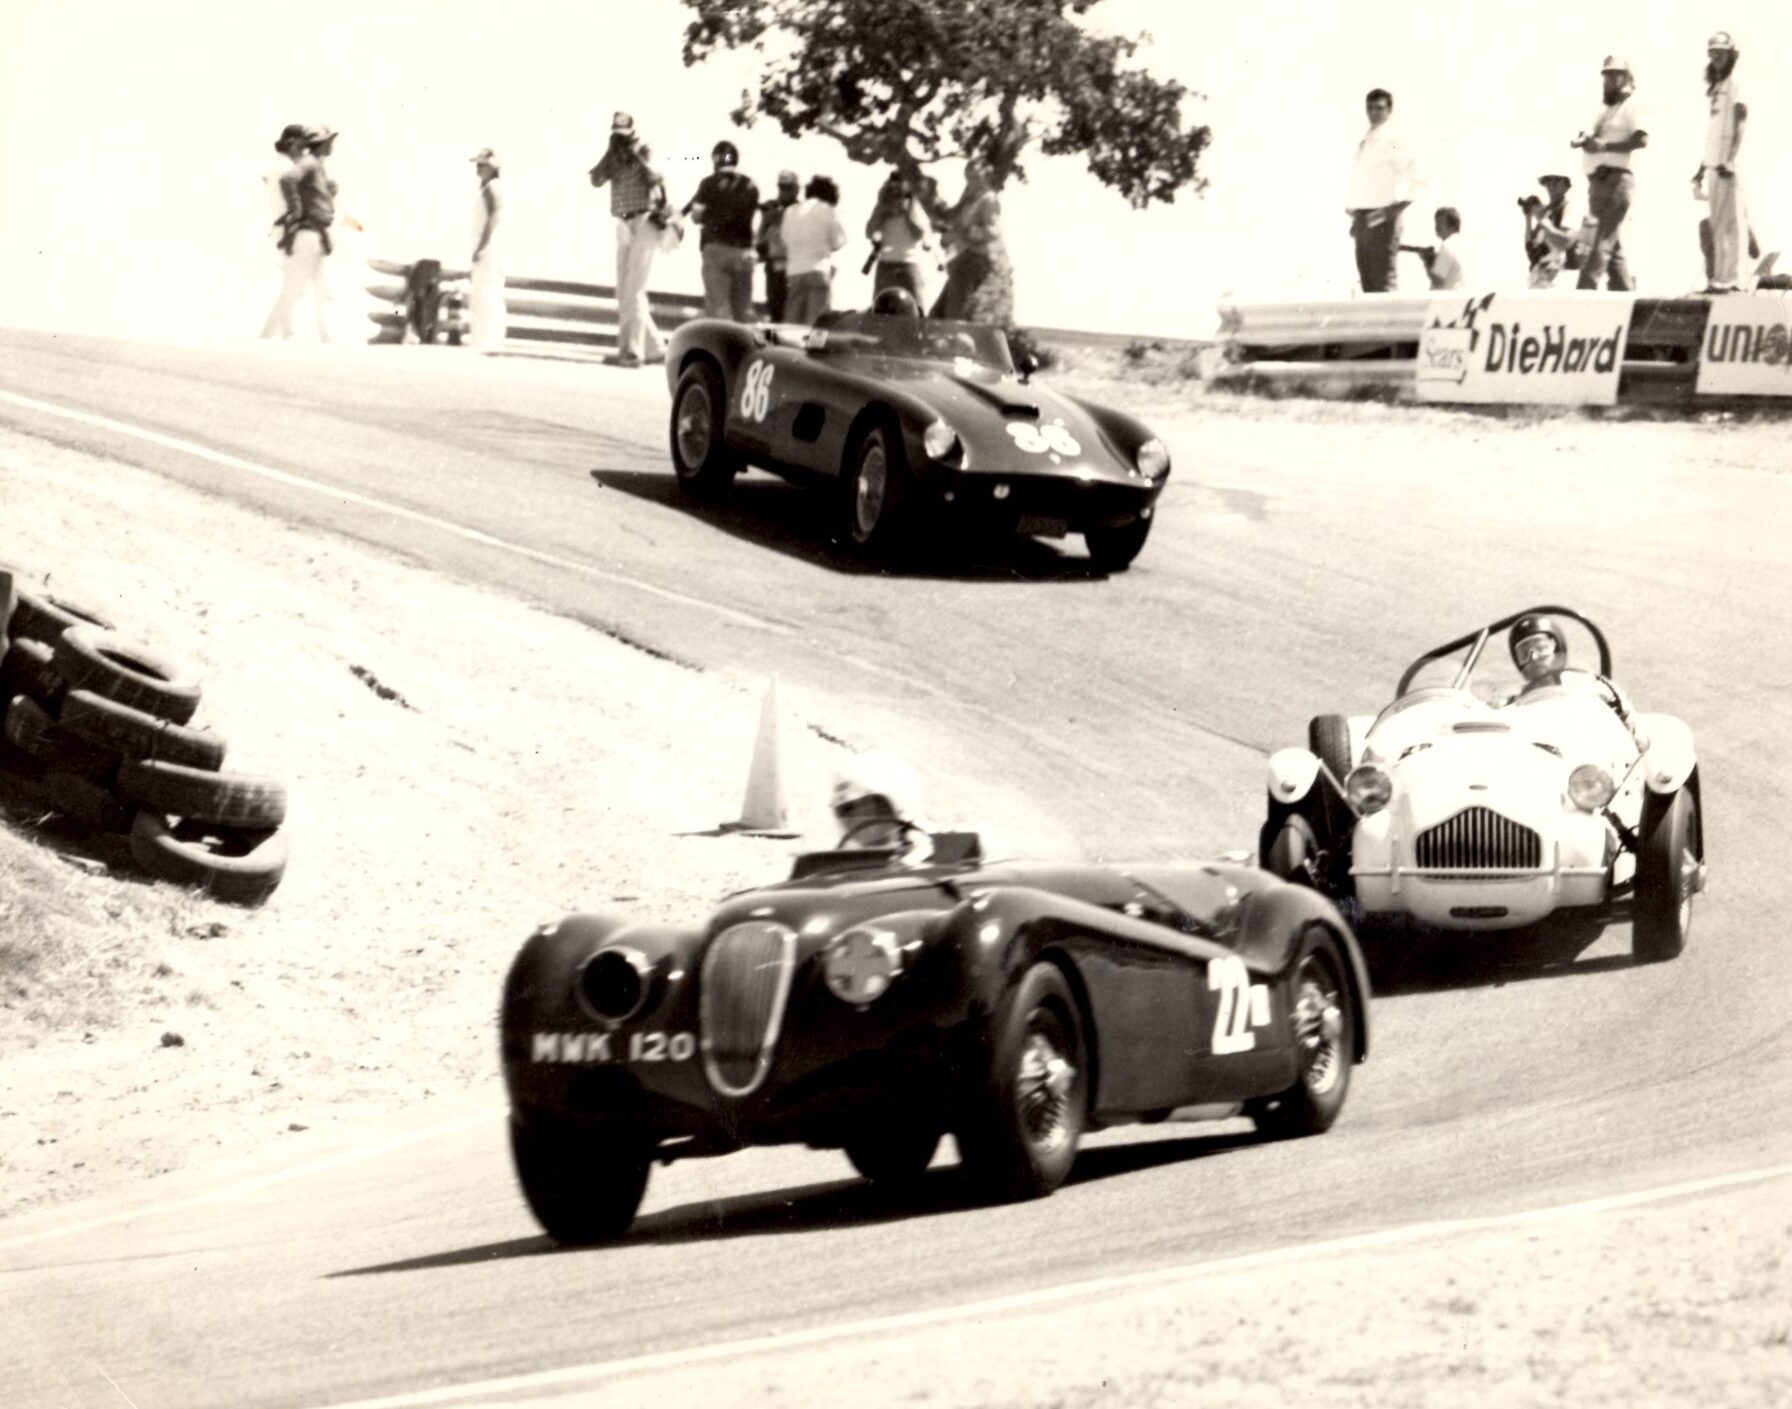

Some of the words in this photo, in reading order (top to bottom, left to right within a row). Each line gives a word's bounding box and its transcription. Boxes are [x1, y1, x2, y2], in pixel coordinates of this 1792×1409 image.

[1484, 322, 1623, 374] DieHard
[741, 358, 775, 422] 86
[630, 1031, 696, 1062] 120
